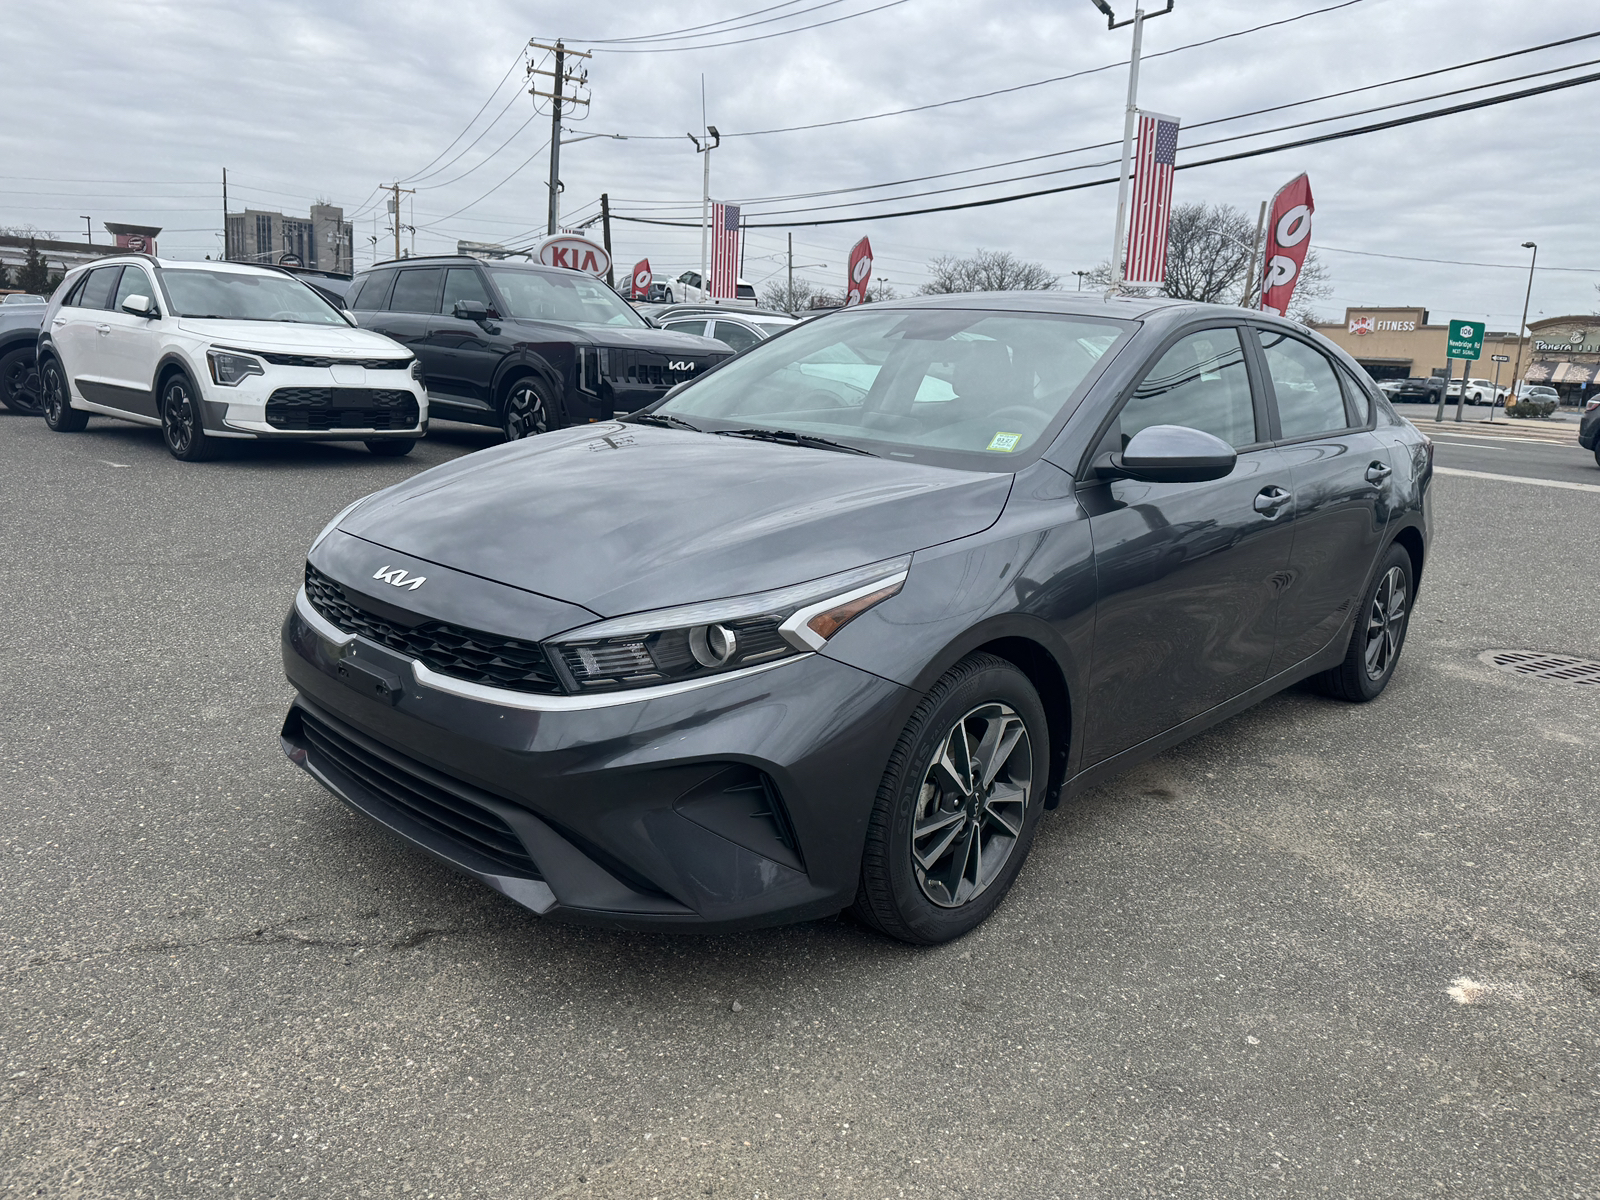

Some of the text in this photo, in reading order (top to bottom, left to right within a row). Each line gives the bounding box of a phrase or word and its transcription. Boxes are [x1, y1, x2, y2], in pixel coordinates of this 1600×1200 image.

[551, 246, 599, 272] KIA
[1377, 320, 1415, 331] FITNESS
[1461, 328, 1472, 336] 106
[1449, 339, 1472, 349] Newbridge
[1535, 340, 1572, 351] Panera
[372, 564, 427, 591] KIA
